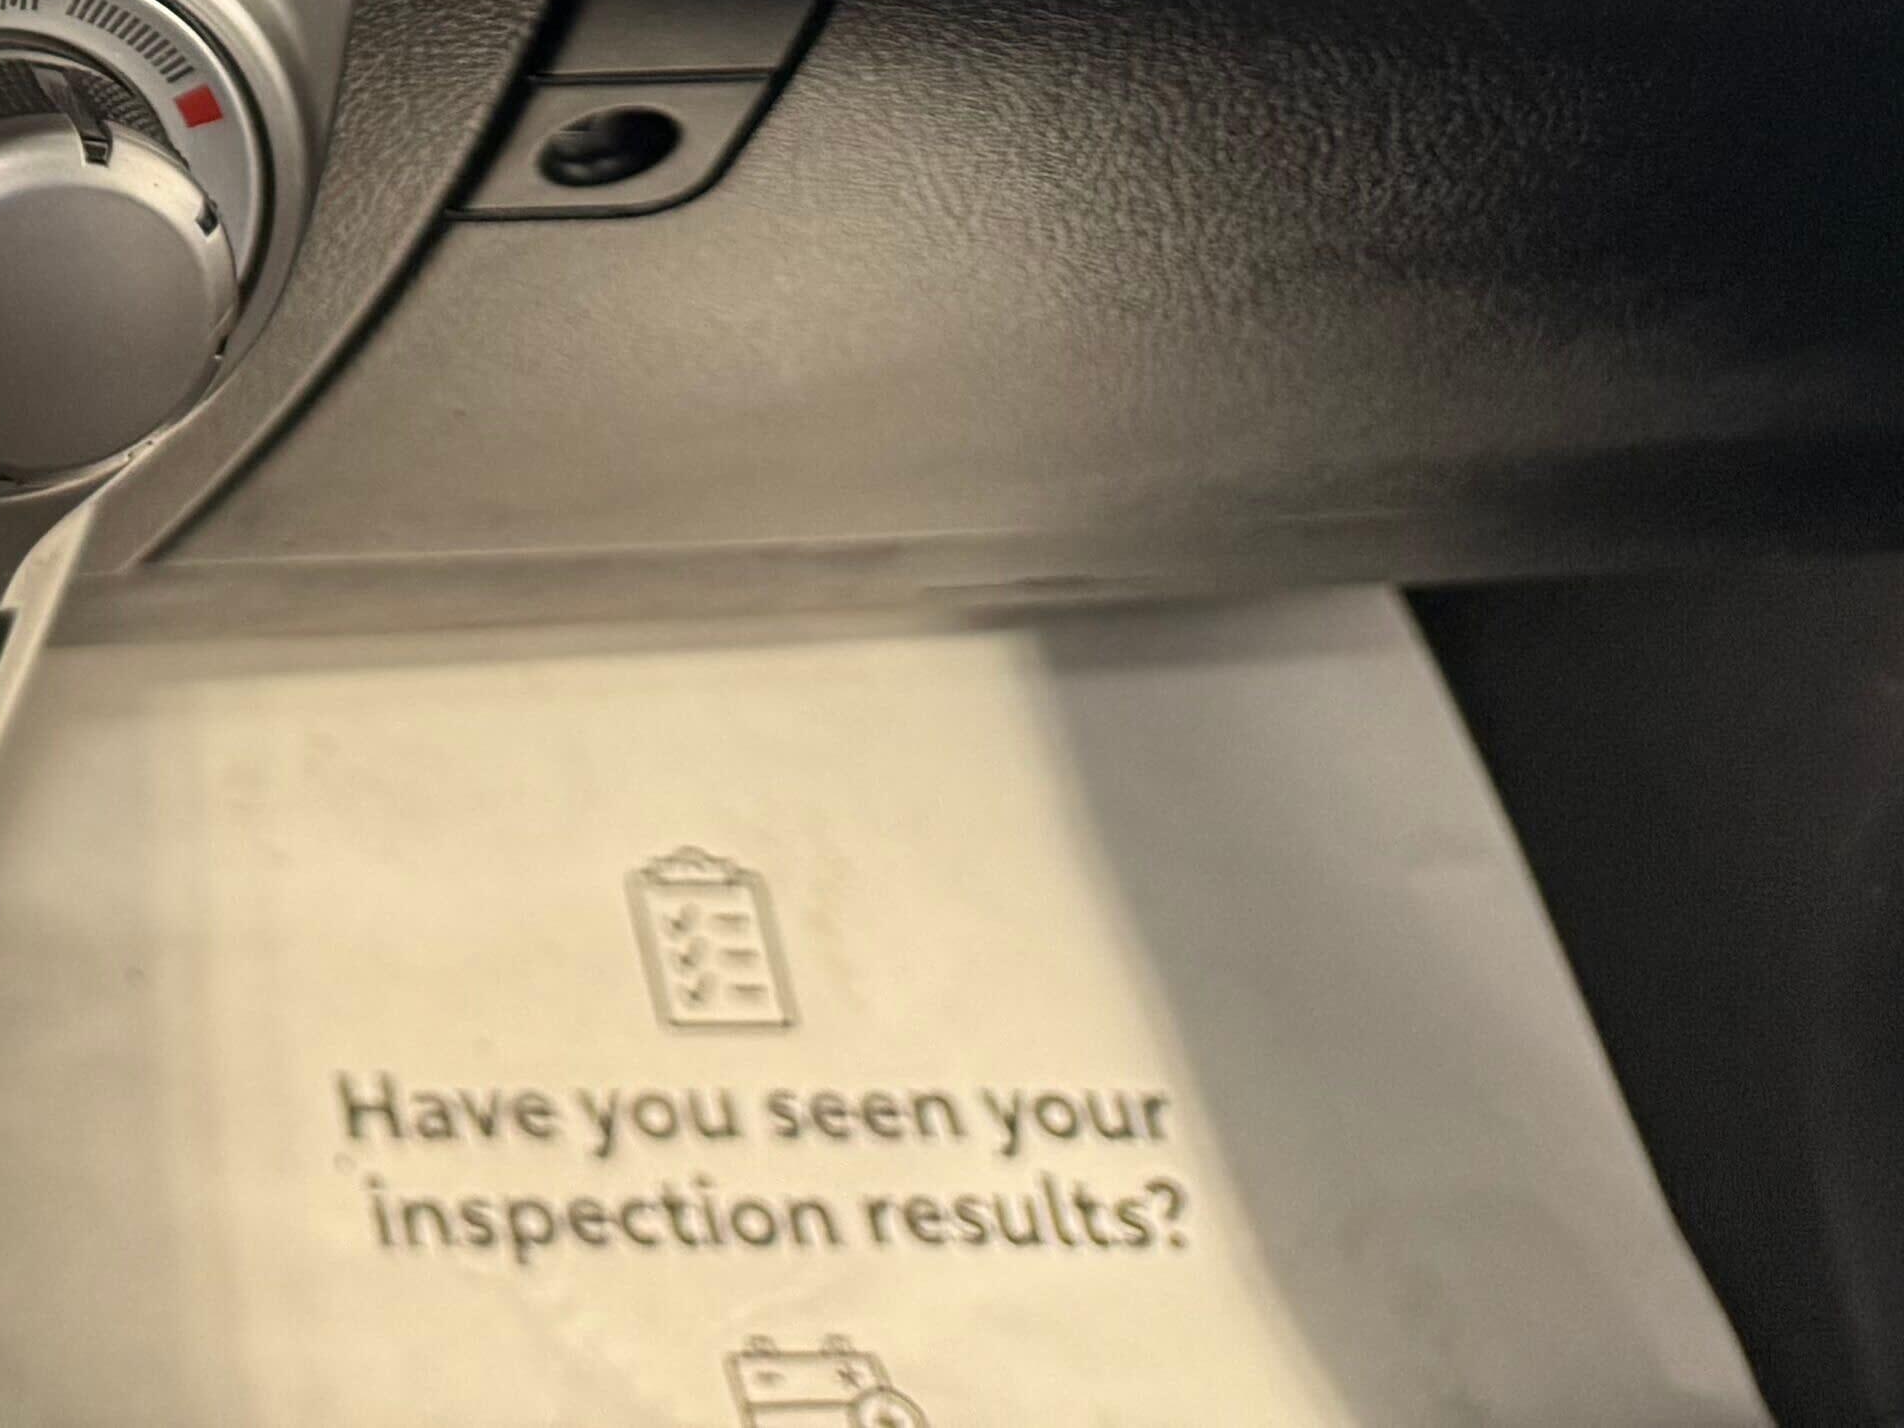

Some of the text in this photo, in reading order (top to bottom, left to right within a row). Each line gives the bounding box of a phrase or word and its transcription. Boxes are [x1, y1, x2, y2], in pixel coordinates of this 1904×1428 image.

[333, 1070, 1174, 1158] Have you seen your
[362, 1172, 1191, 1263] inspection results?
